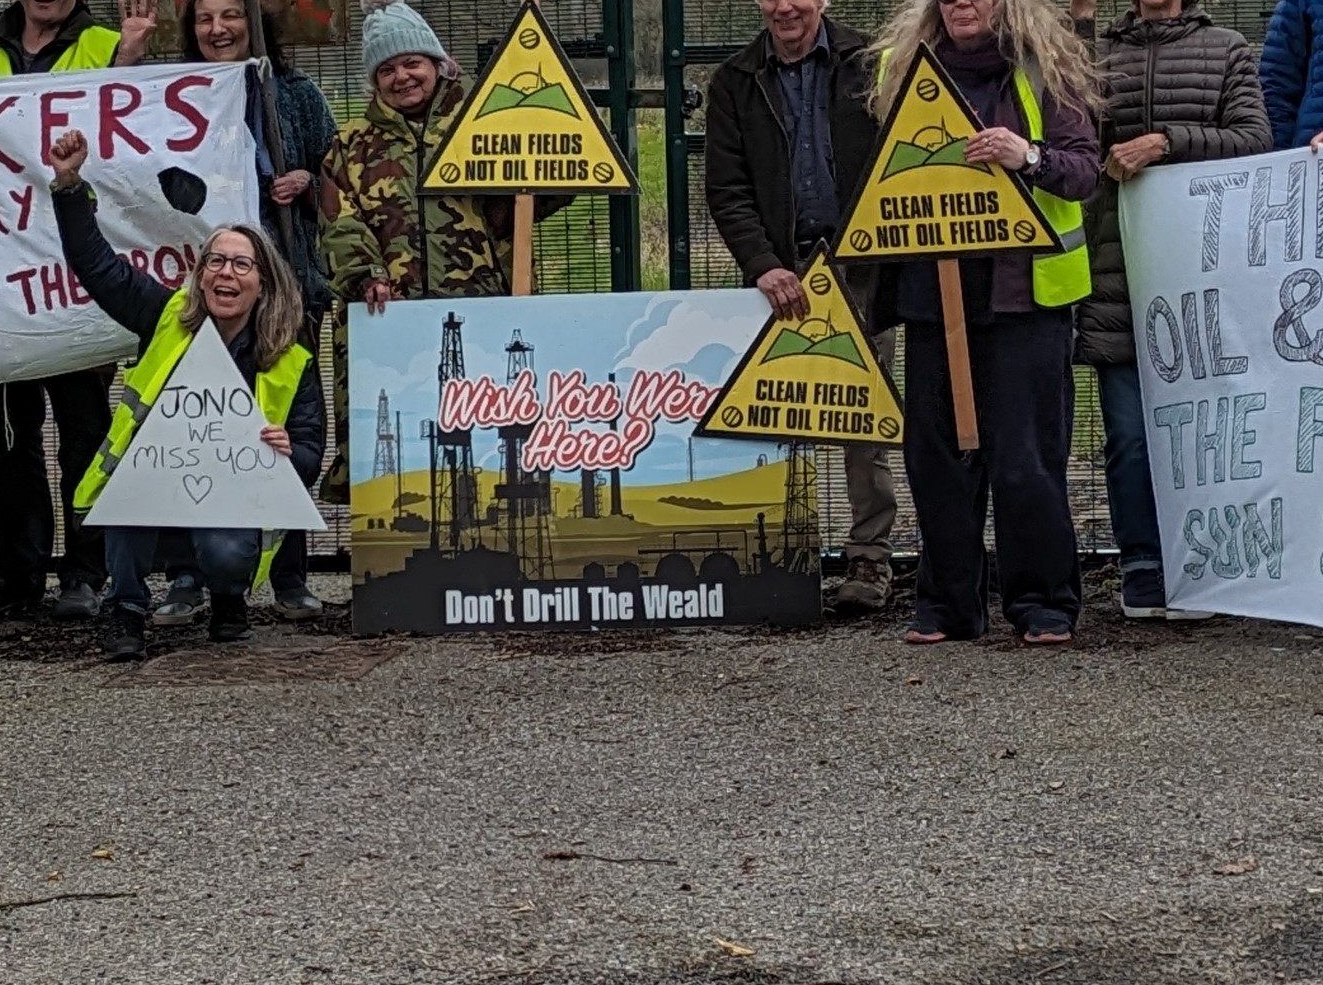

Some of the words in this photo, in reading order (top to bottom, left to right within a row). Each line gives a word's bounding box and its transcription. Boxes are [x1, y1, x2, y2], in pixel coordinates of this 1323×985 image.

[472, 133, 521, 156] CLEAN
[528, 133, 583, 155] FIELDS
[465, 160, 497, 181] NOT
[502, 159, 529, 181] OIL
[534, 159, 589, 181] FIELDS
[879, 195, 935, 221] CLEAN
[940, 190, 1000, 218] FIELDS
[876, 224, 910, 249] NOT
[916, 221, 946, 247] OIL
[950, 218, 1010, 245] FIELDS
[1145, 288, 1249, 384] OIL
[160, 385, 254, 419] JONO
[440, 369, 540, 431] Wish
[546, 370, 620, 421] You
[755, 379, 808, 404] CLEAN
[813, 382, 870, 408] FIELDS
[187, 421, 226, 444] WE
[747, 405, 782, 429] NOT
[786, 408, 813, 431] OIL
[818, 410, 875, 435] FIELDS
[524, 417, 652, 471] Here?
[1154, 392, 1267, 490] THE
[132, 446, 201, 469] MISS
[216, 446, 278, 475] YOU
[1183, 497, 1284, 582] SUN
[444, 588, 516, 625] Don't
[522, 586, 580, 624] Drill
[587, 586, 634, 621] The
[641, 583, 725, 620] Weald
